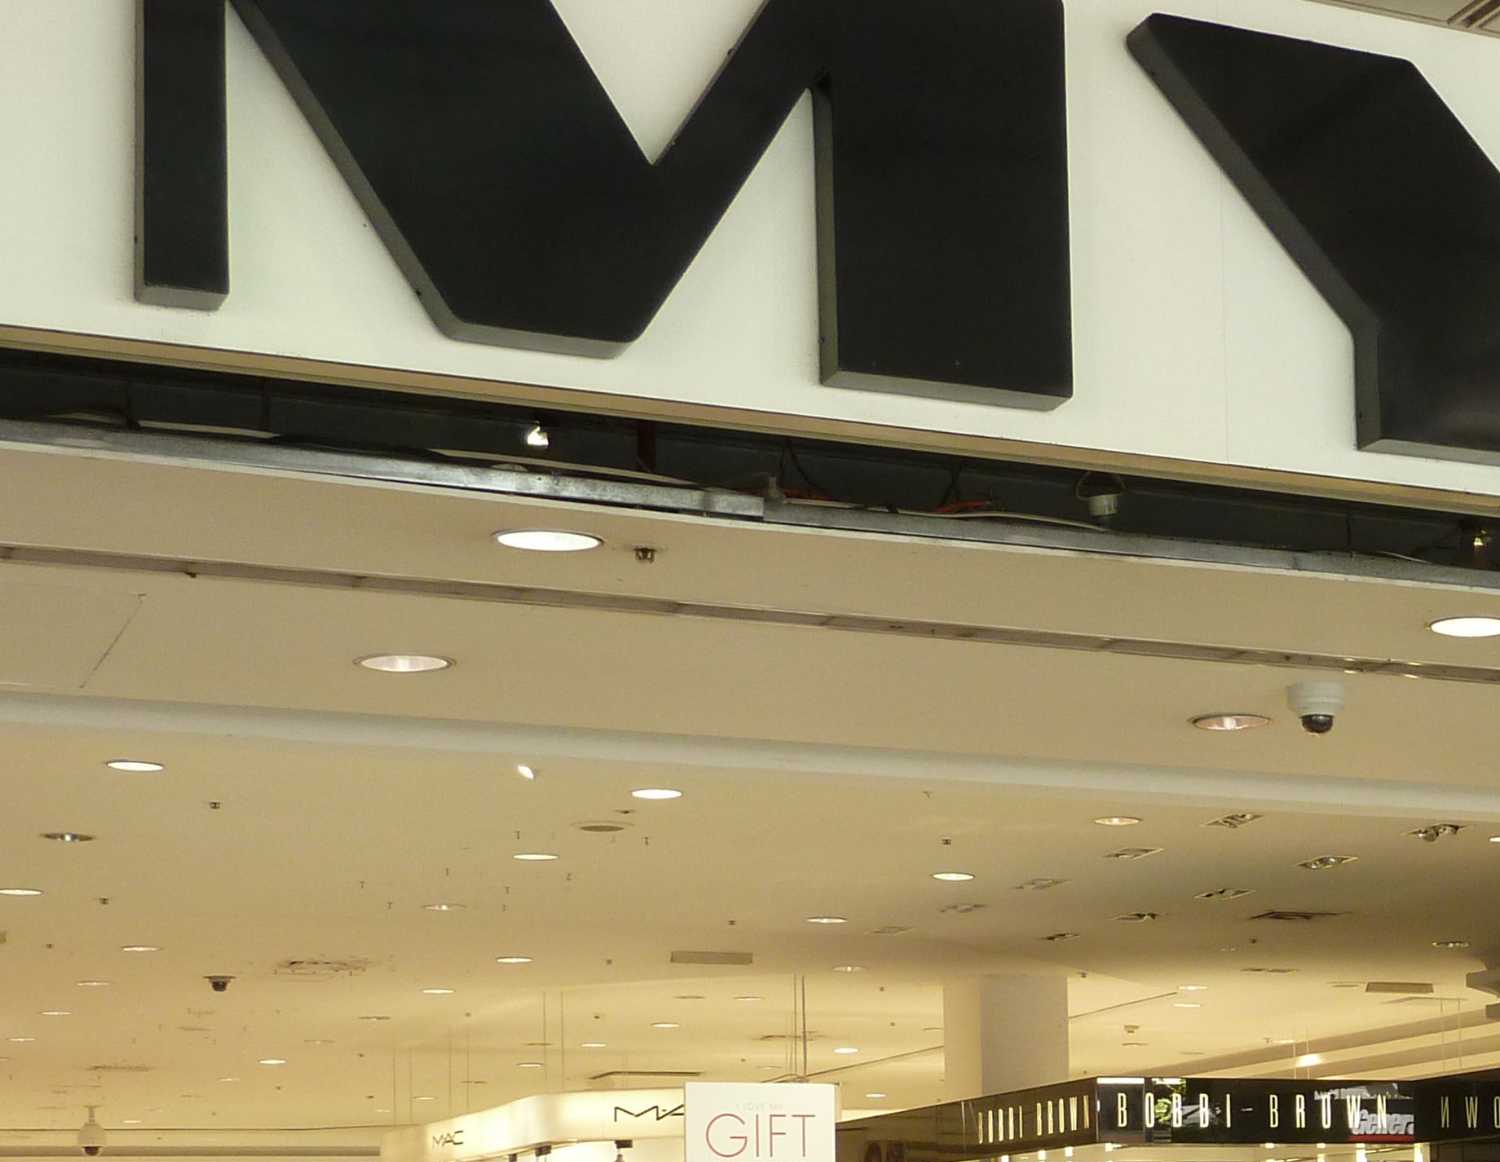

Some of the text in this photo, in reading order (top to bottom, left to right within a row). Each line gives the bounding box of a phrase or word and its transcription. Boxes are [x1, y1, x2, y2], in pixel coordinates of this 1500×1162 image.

[1117, 1092, 1388, 1129] BOBBI BROWN
[705, 1113, 816, 1158] GIFT
